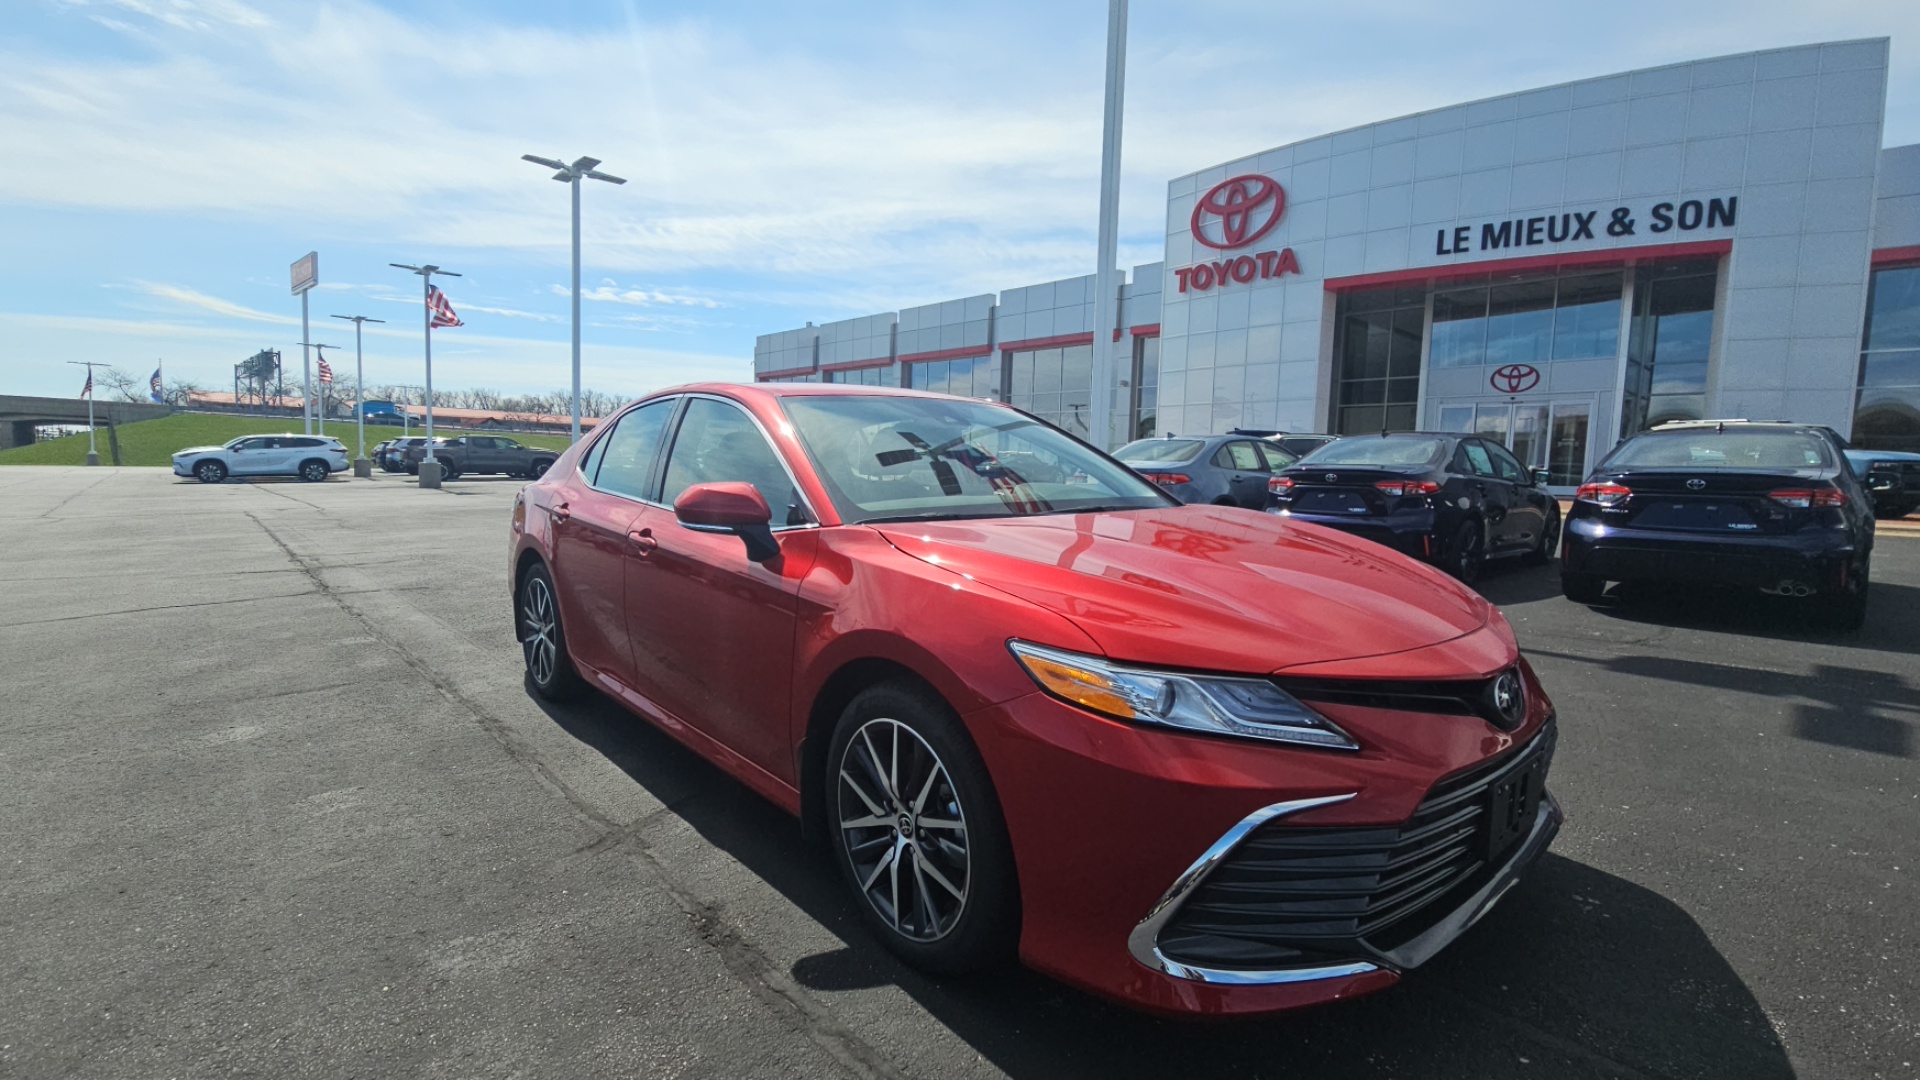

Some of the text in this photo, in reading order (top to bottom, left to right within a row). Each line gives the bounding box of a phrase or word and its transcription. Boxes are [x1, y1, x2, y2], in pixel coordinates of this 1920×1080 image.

[1436, 196, 1738, 255] LE MIEUX & SON
[1174, 247, 1300, 293] TOYOTA
